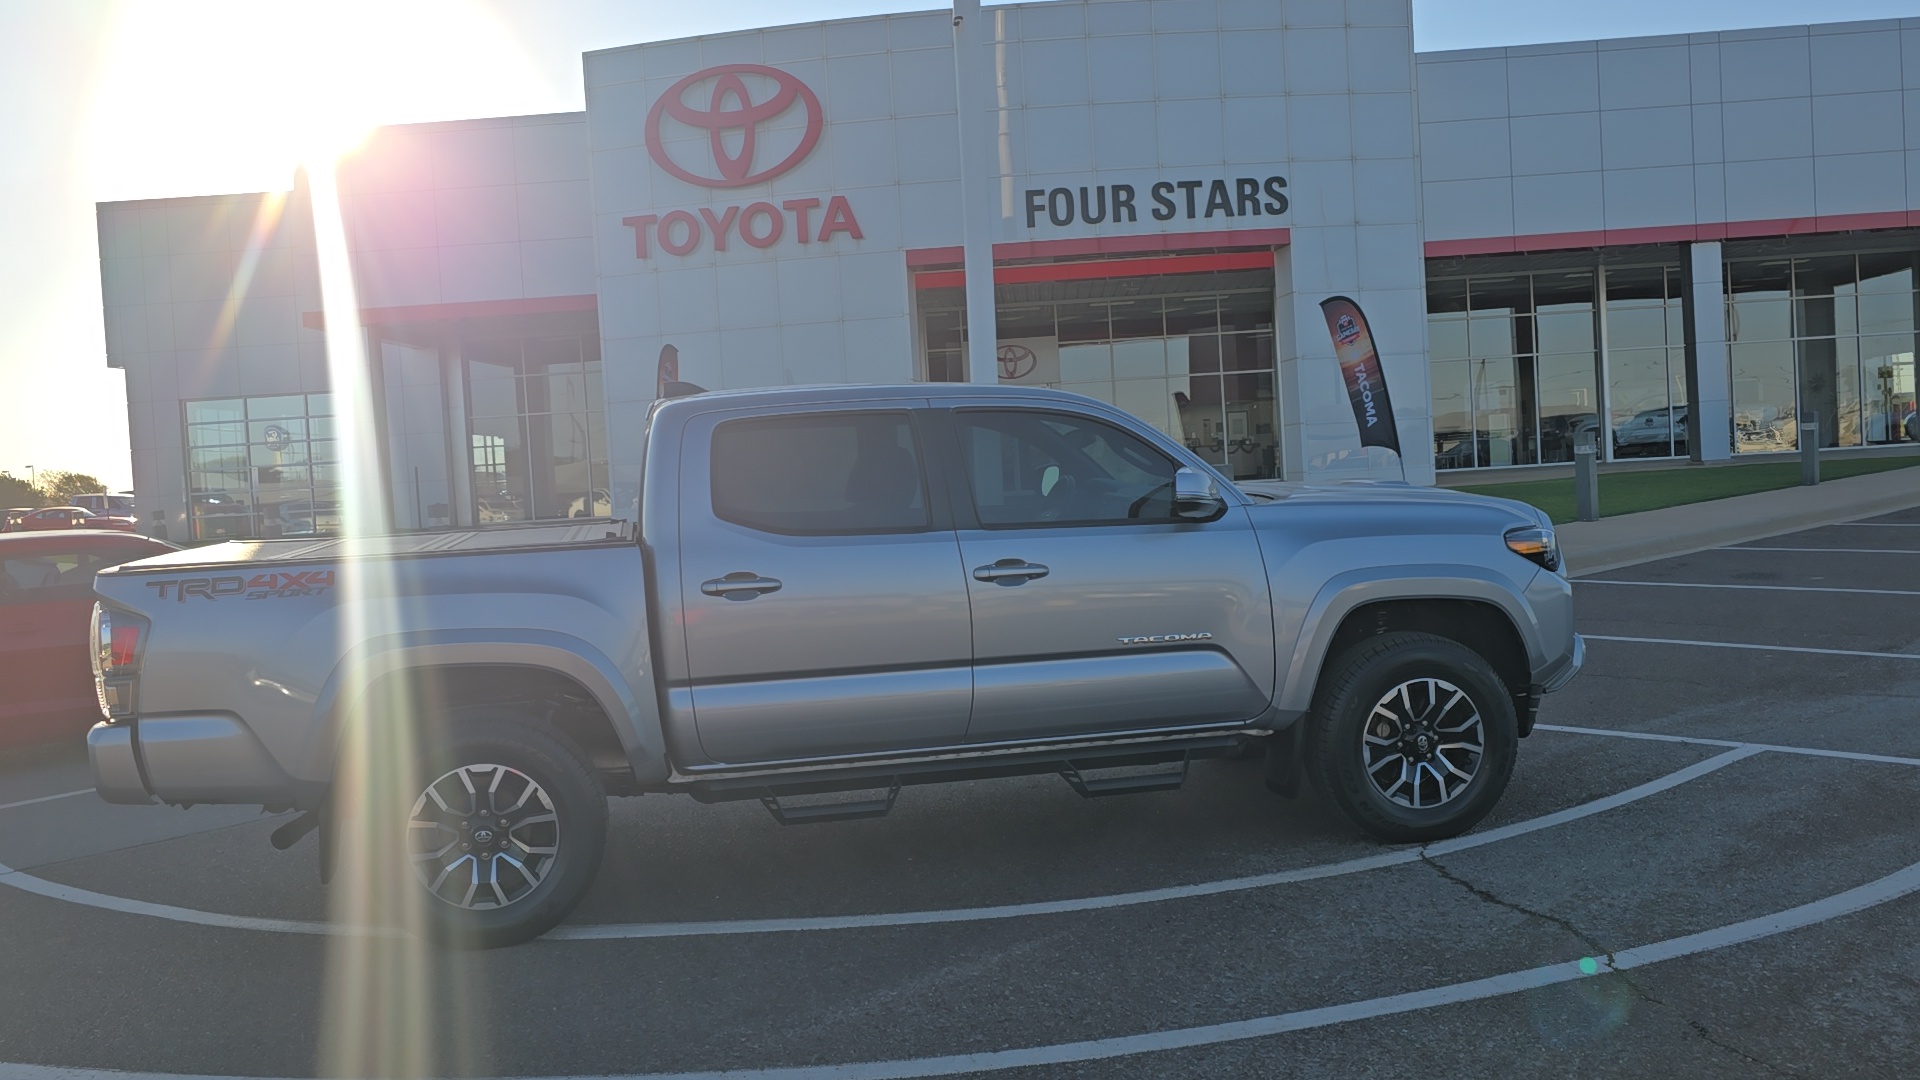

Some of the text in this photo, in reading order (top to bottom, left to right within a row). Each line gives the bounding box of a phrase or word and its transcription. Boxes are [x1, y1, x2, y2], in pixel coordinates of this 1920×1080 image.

[1025, 176, 1289, 228] FOUR STARS
[622, 195, 864, 259] TOYOTA
[1354, 363, 1378, 428] TACOMA
[146, 571, 335, 604] TRD 4X4
[245, 586, 330, 600] SPORT
[1117, 632, 1213, 645] TACOMA
